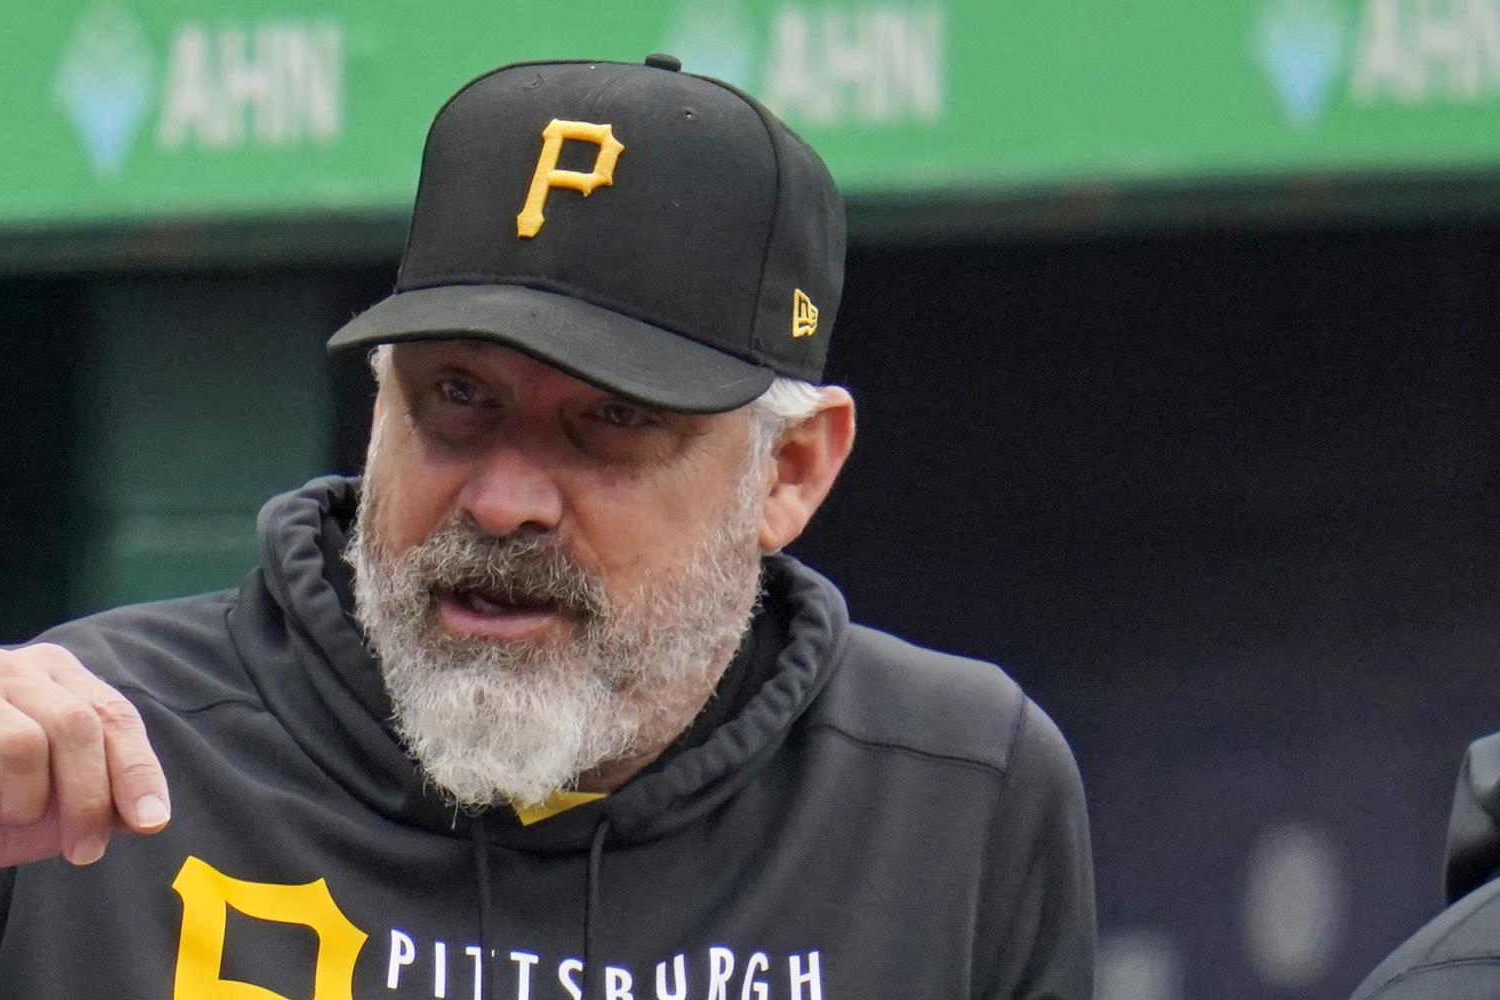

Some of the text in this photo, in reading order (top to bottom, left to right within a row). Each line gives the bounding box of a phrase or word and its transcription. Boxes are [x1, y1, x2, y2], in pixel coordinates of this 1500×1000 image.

[156, 22, 342, 148] AHN
[763, 8, 943, 122] AHN
[516, 118, 625, 238] P
